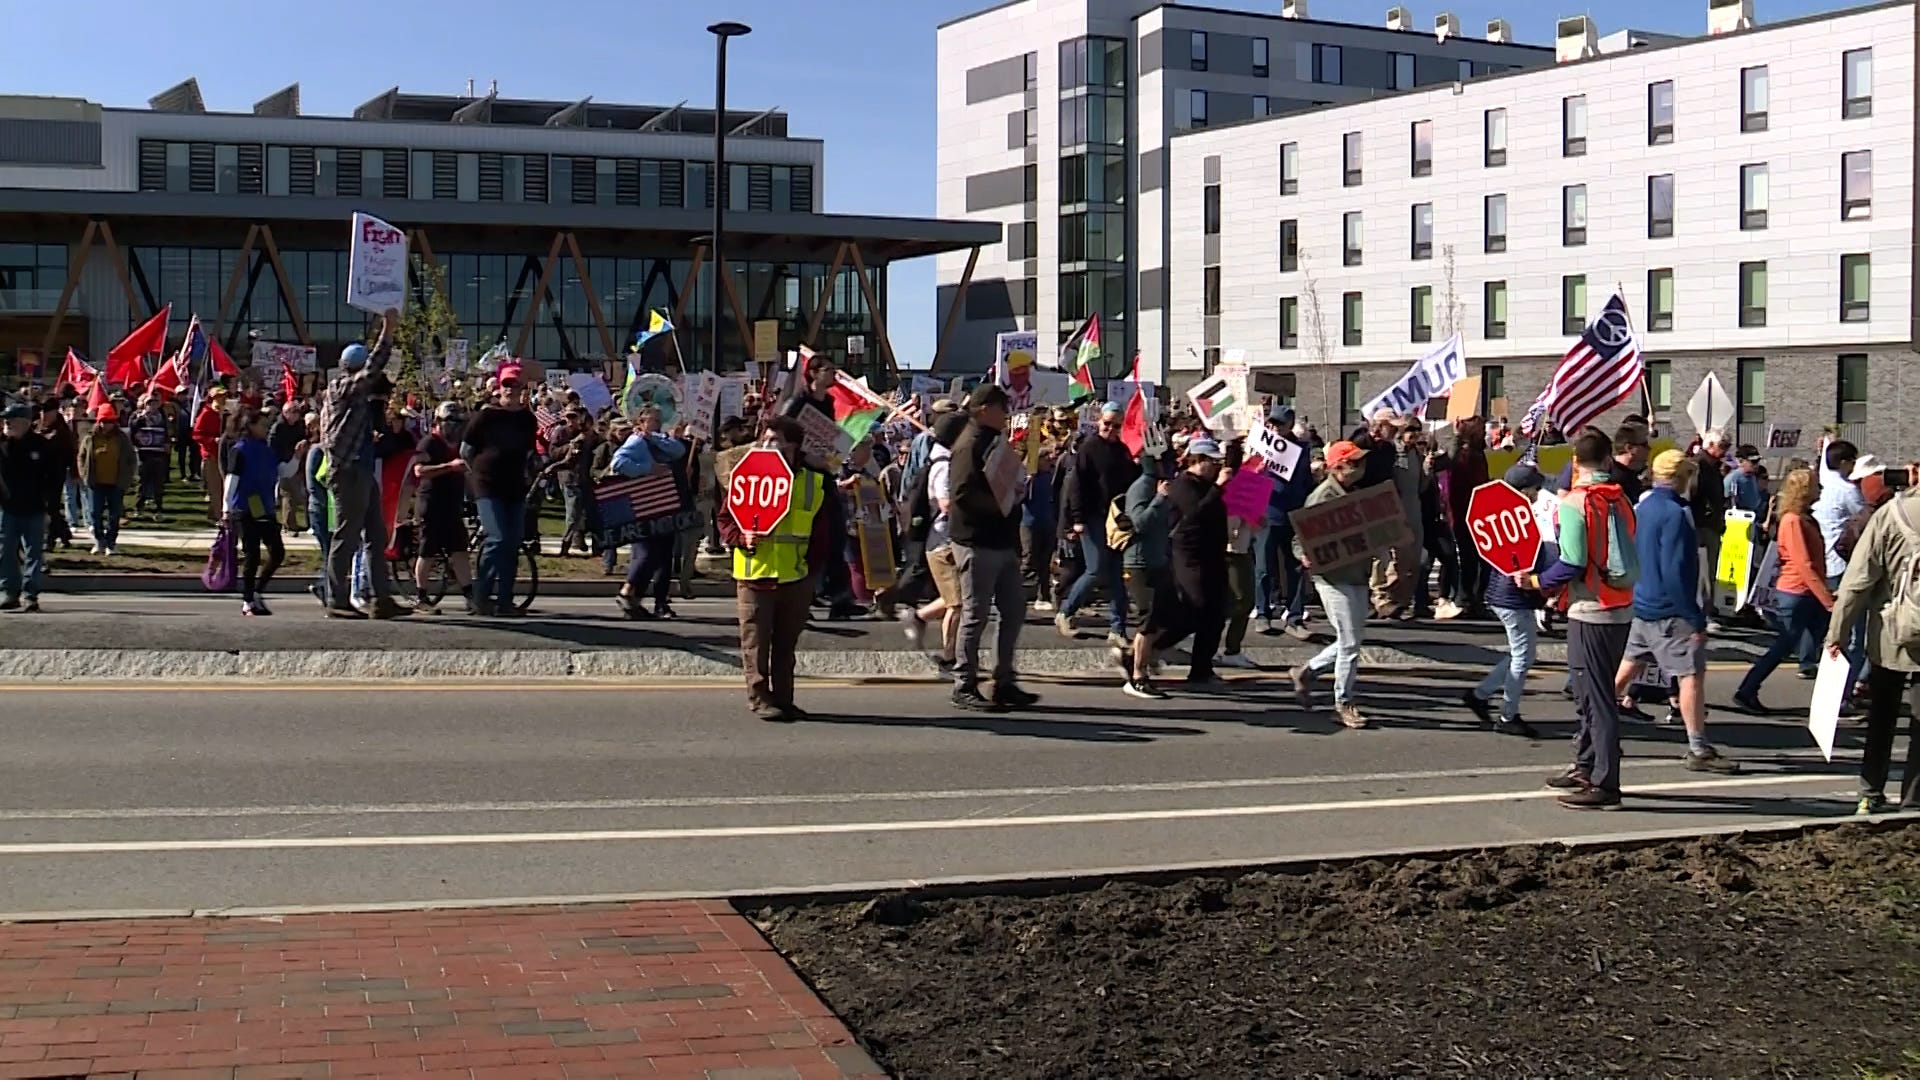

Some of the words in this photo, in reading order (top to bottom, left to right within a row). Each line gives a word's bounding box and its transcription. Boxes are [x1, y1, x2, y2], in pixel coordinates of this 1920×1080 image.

[1260, 429, 1287, 452] NO
[731, 474, 790, 508] STOP
[620, 520, 649, 543] ARE
[1473, 505, 1531, 552] STOP
[1313, 540, 1340, 566] EAT
